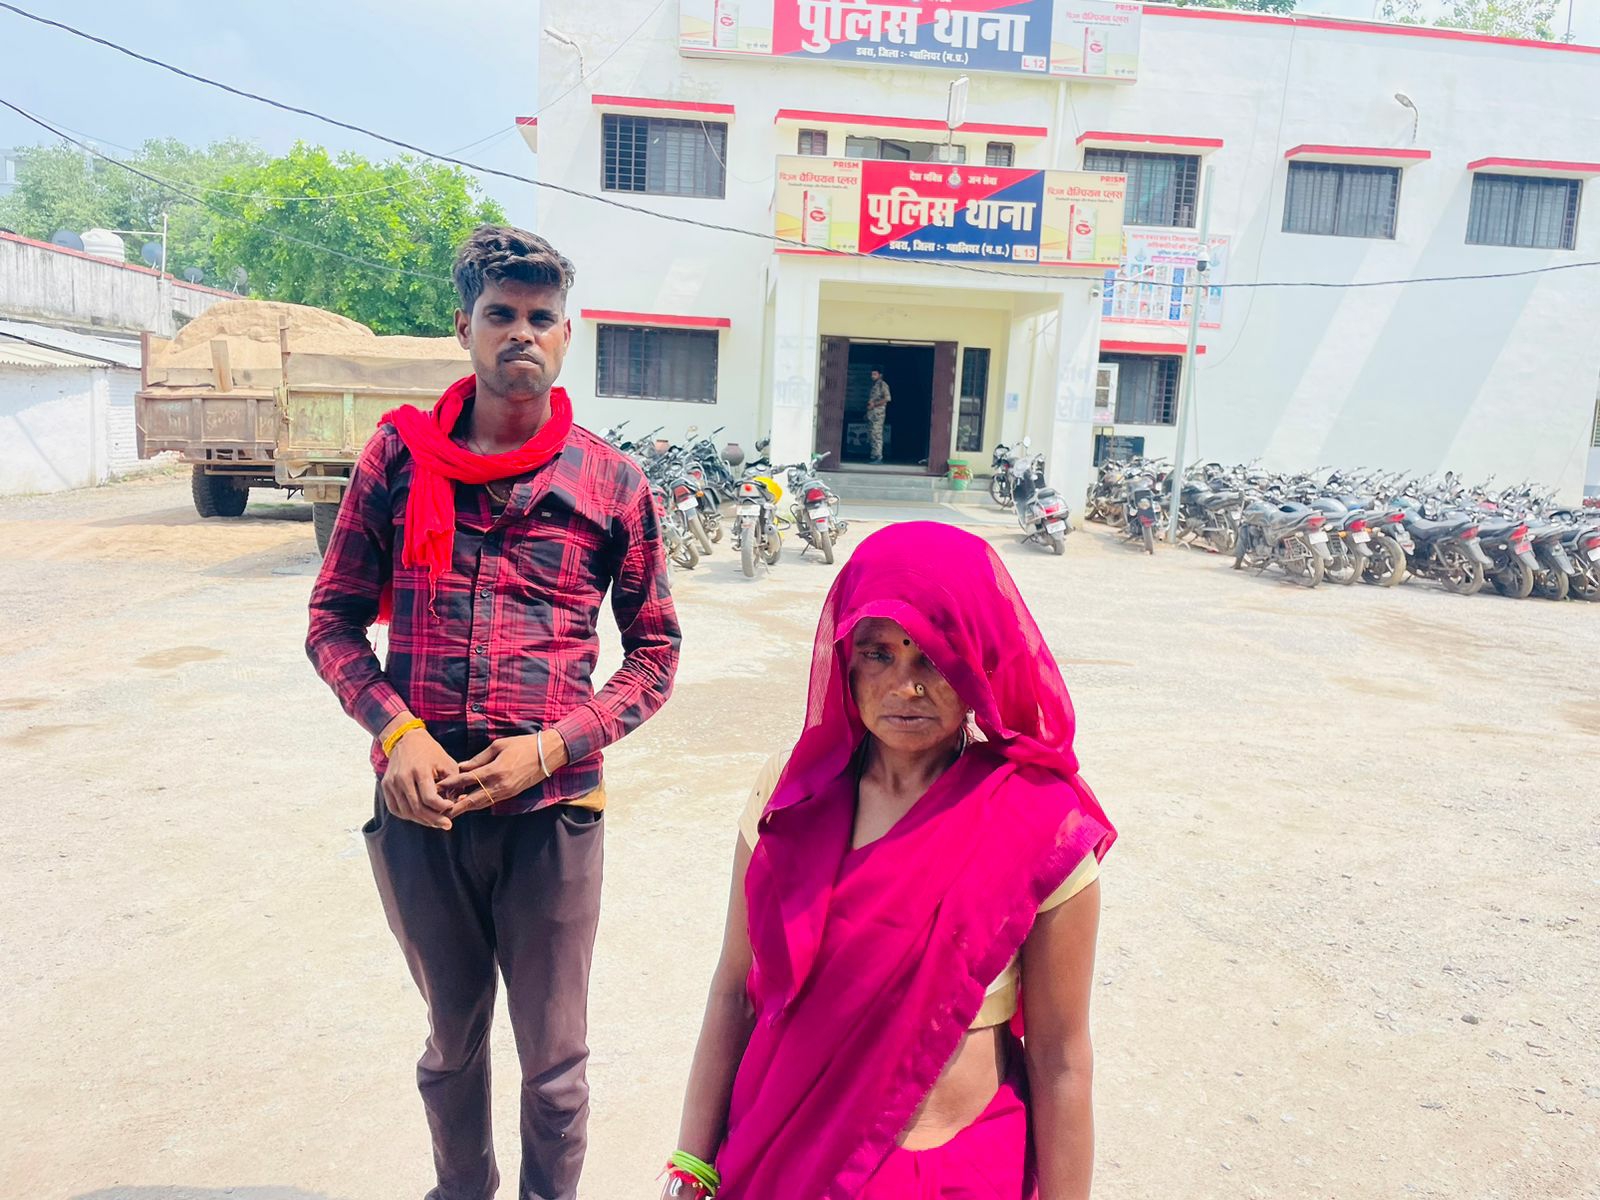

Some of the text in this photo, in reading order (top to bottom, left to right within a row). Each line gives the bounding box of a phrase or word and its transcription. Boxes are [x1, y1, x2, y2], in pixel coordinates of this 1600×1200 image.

[797, 0, 1030, 54] पुलिस थाना
[833, 161, 859, 169] PRISM
[867, 186, 1036, 236] पुलिस थाना
[1024, 248, 1036, 258] 13
